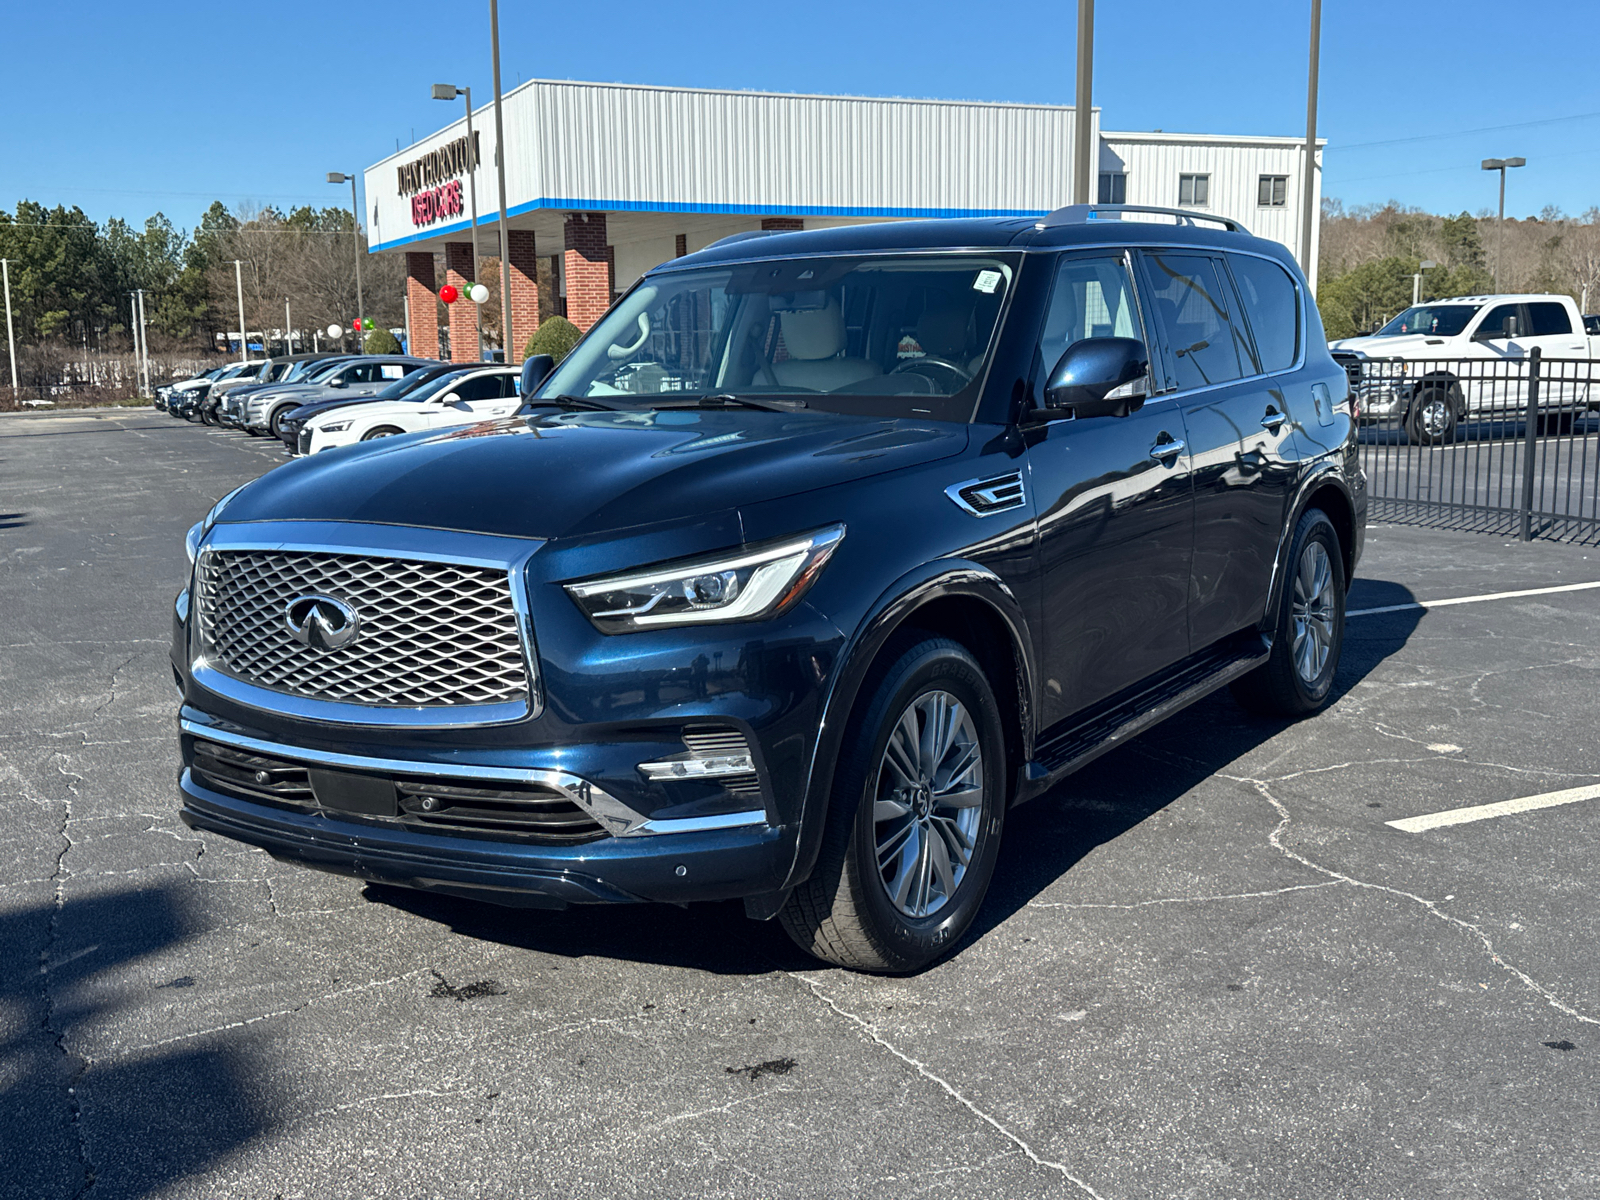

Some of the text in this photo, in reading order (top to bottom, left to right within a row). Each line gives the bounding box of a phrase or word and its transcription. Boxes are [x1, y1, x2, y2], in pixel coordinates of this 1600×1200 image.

[397, 130, 480, 195] JOHN THORNTON
[411, 179, 461, 225] USED CARS
